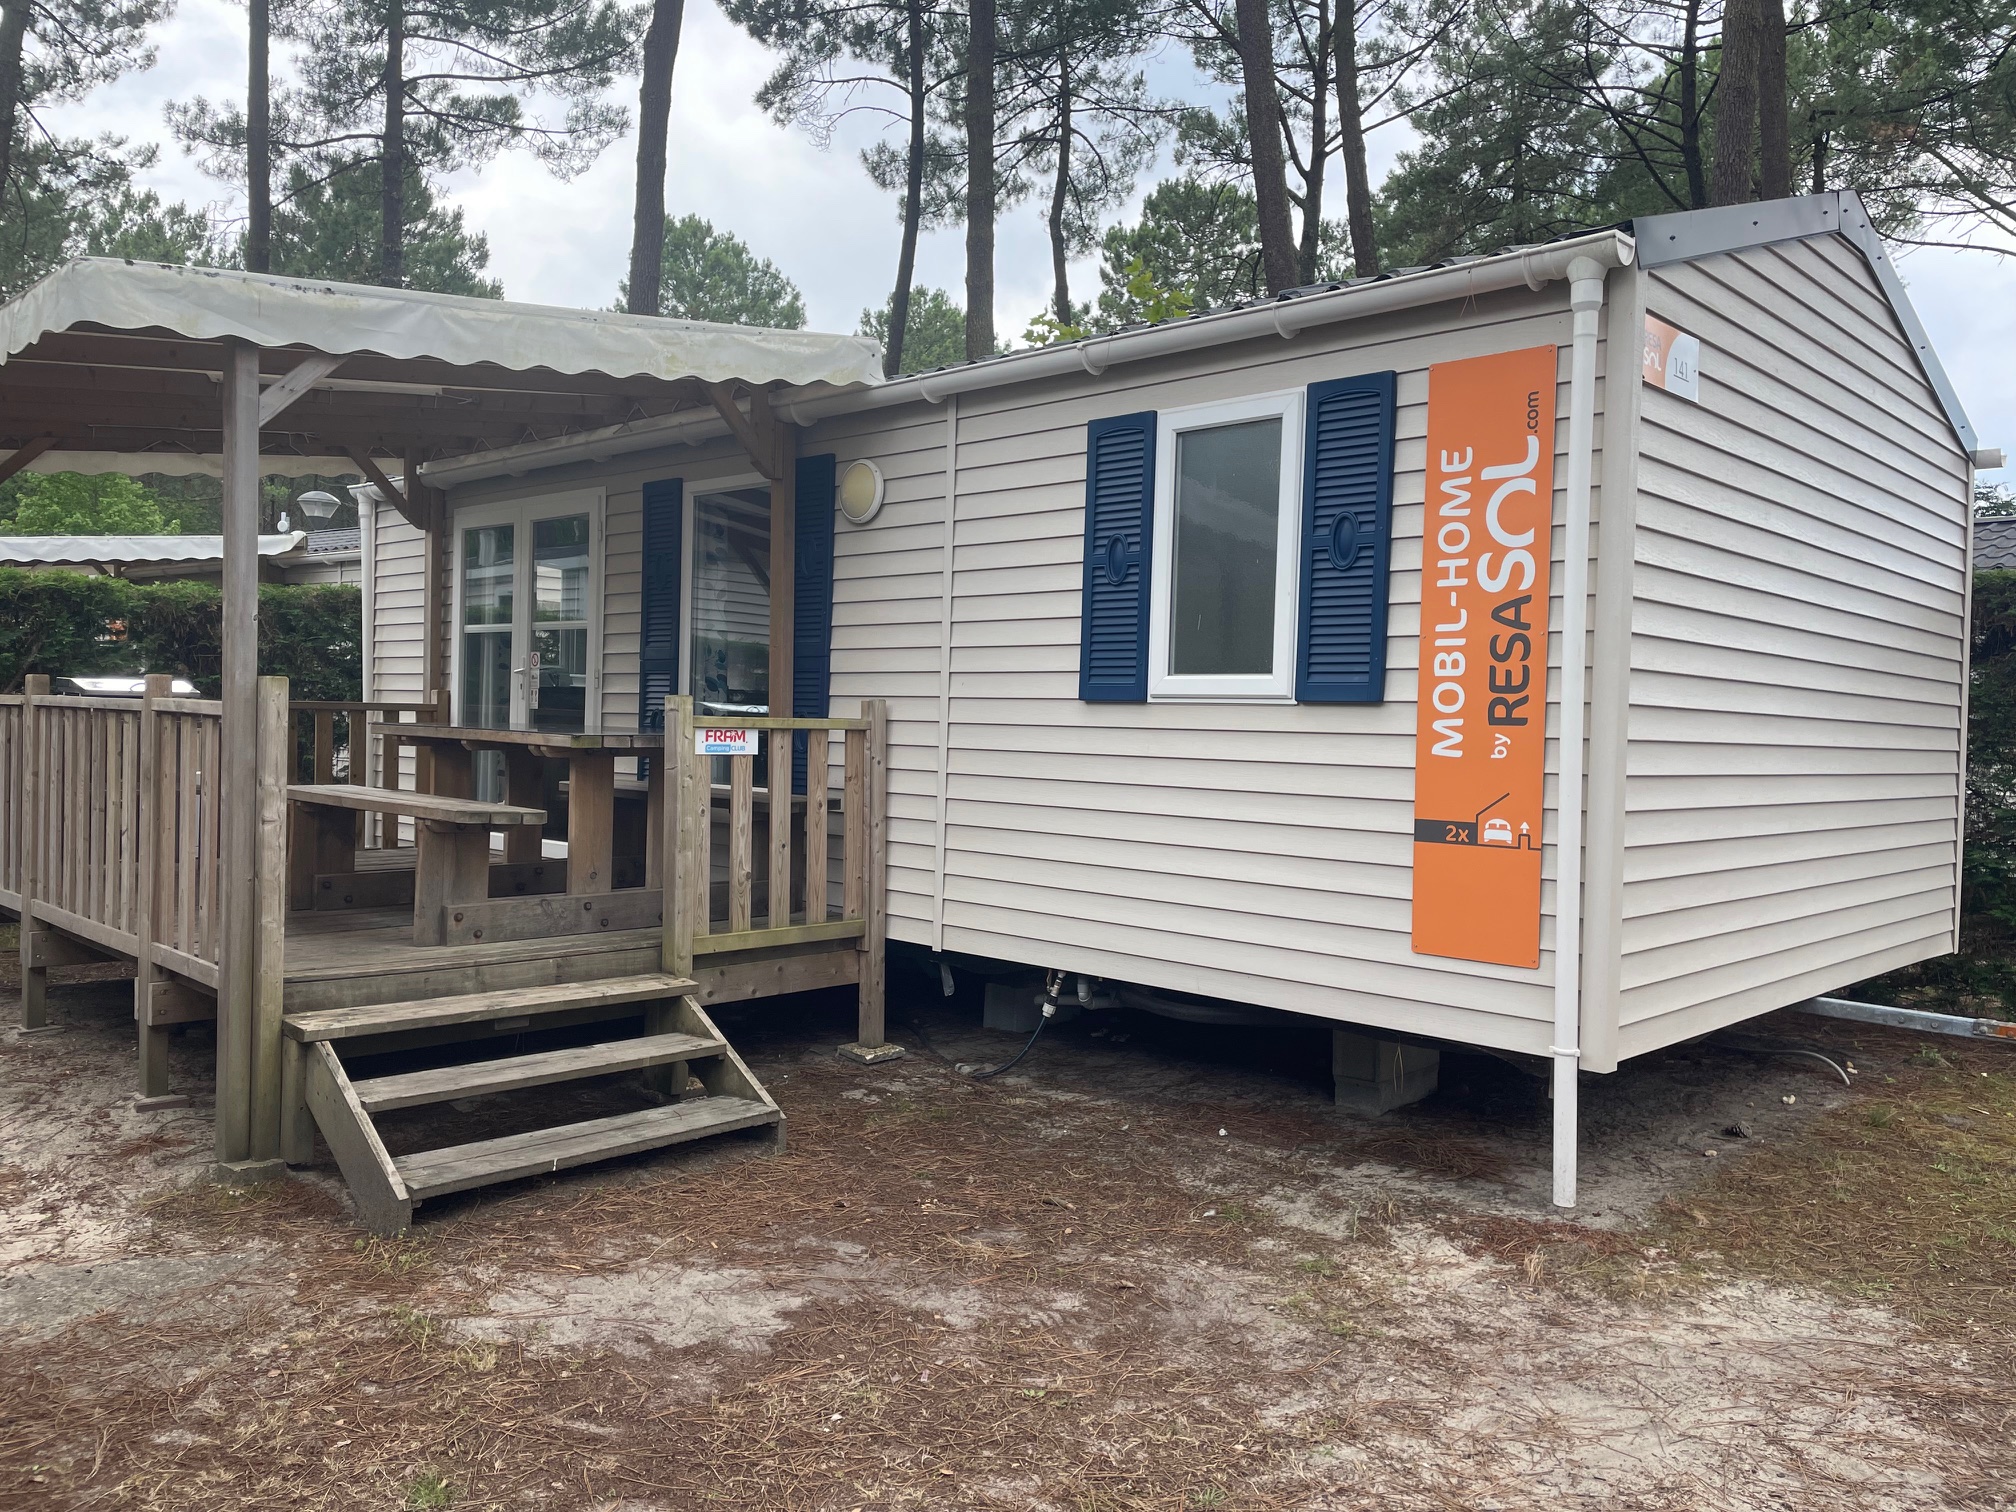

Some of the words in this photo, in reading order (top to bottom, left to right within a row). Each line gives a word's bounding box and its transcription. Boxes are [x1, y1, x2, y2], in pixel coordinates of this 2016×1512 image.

[1674, 358, 1688, 379] 141
[1431, 446, 1474, 758] MOBIL-HOME
[705, 729, 746, 742] FRAM
[1490, 732, 1511, 760] by
[1445, 824, 1470, 843] 2x
